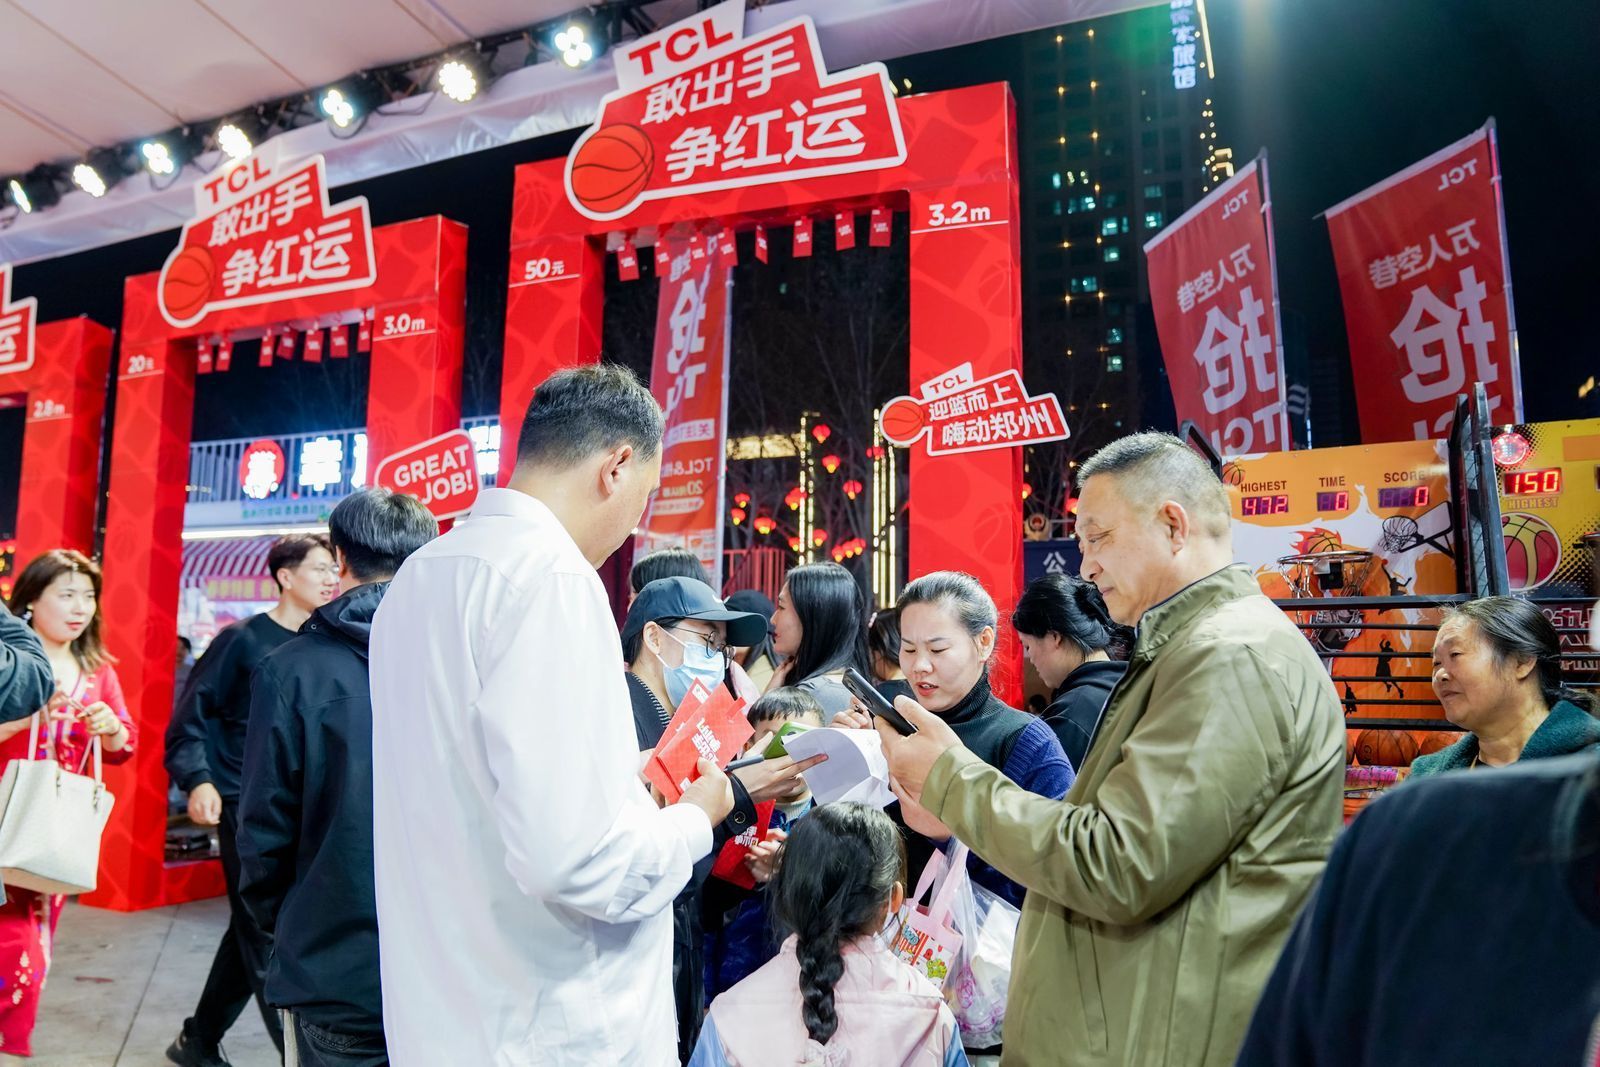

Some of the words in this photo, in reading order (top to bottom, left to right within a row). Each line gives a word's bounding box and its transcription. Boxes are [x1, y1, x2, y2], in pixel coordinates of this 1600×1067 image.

[629, 18, 733, 77] TCL
[641, 35, 800, 125] 敢出手
[665, 88, 867, 182] 争红运
[204, 158, 271, 204] TCL
[208, 172, 313, 247] 敢出手
[928, 201, 991, 227] 3.2m
[222, 218, 353, 297] 争红运
[524, 257, 565, 280] 50元
[383, 313, 425, 336] 3.0m
[929, 374, 967, 394] TCL
[928, 382, 1019, 422] 迎篮而上
[942, 402, 1056, 446] 嗨动郑州
[393, 444, 469, 488] GREAT
[1383, 470, 1426, 483] SCORE
[421, 468, 474, 505] JOB!
[1240, 480, 1288, 493] HIGHEST
[1319, 476, 1346, 488] TIME
[1514, 470, 1559, 495] 150
[1244, 495, 1288, 516] 472
[1335, 491, 1349, 511] 0
[1414, 485, 1429, 507] 0
[1508, 496, 1559, 509] HIGHEST
[1043, 551, 1066, 574] 公
